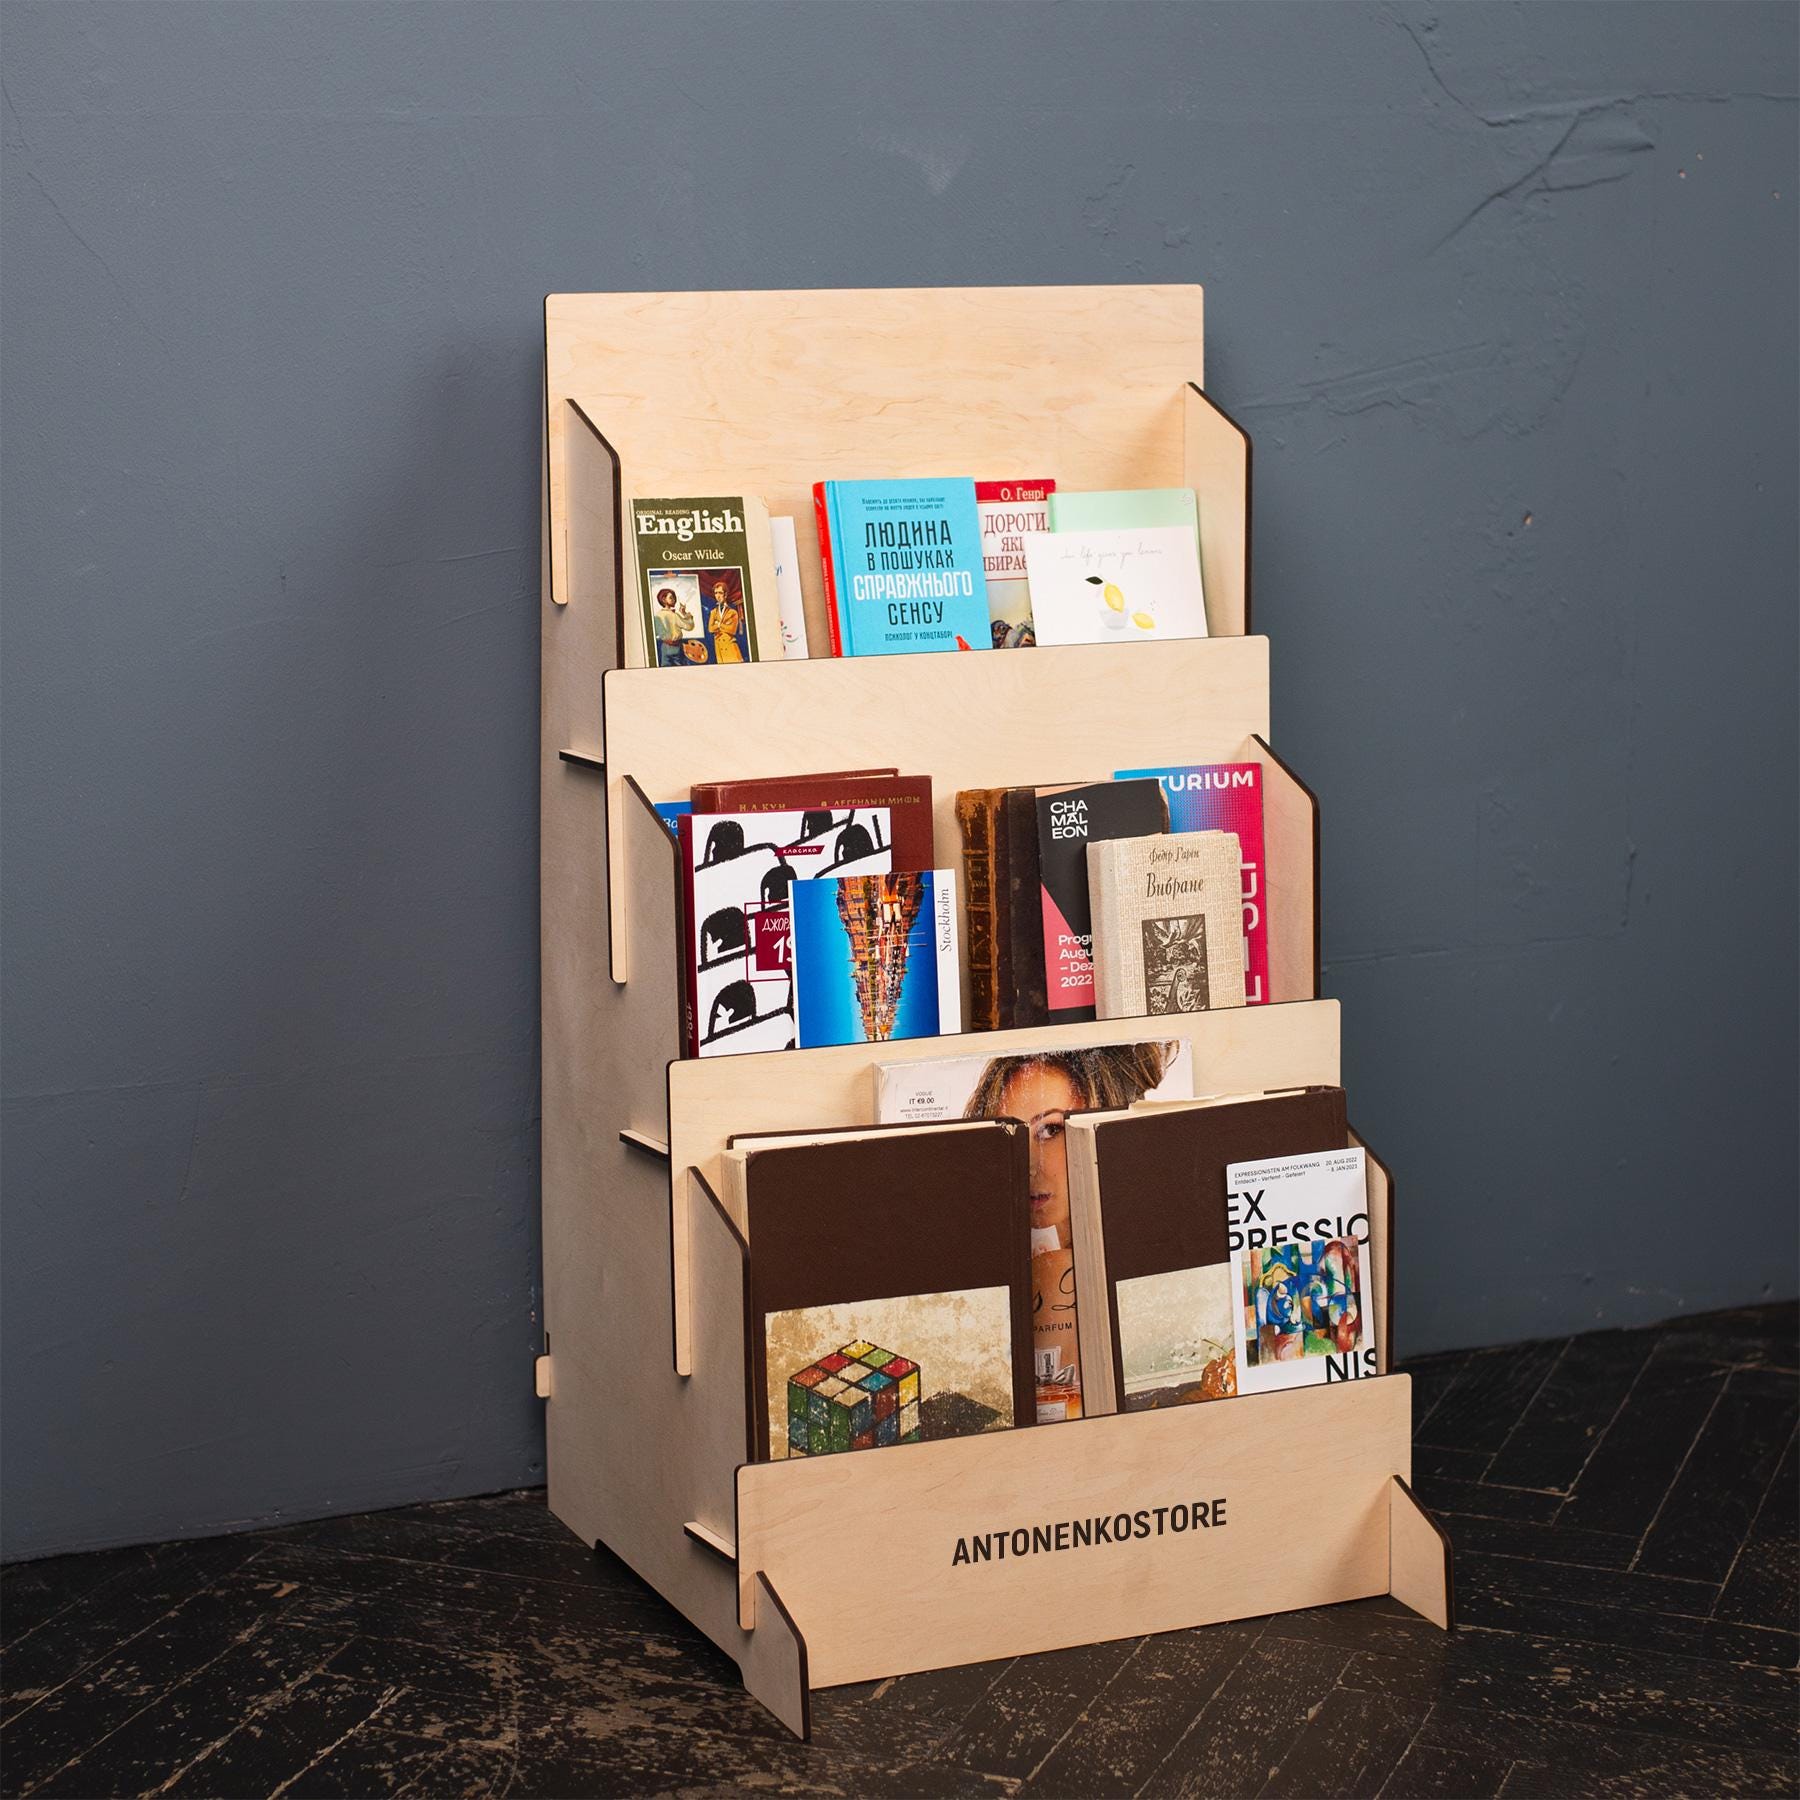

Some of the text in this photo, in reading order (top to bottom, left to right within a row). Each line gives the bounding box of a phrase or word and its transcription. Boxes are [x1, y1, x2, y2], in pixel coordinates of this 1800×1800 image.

[1016, 487, 1045, 501] Генрі
[636, 509, 744, 542] English
[865, 520, 953, 549] ЛЮДИНА
[984, 512, 1050, 538] ДОРОГИ,
[662, 549, 725, 561] Oscar Wilde
[1001, 536, 1025, 552] ЯКІ
[867, 549, 954, 571] В ПОШУКАХ
[853, 571, 973, 601] СПРАВЖНЬОГО
[887, 601, 944, 625] СЕНСУ
[1050, 800, 1088, 814] CHA
[1051, 825, 1088, 839] EON
[1146, 872, 1204, 900] Вибране
[937, 888, 952, 952] Stockholm
[1070, 961, 1094, 973] Dez
[1061, 974, 1093, 988] 2022
[1234, 1167, 1280, 1178] EXPRESSIONISTEN
[1290, 1162, 1320, 1171] FOLKWANG
[1227, 1189, 1267, 1225] EX
[951, 1498, 1228, 1567] ANTONENKOSTORE
